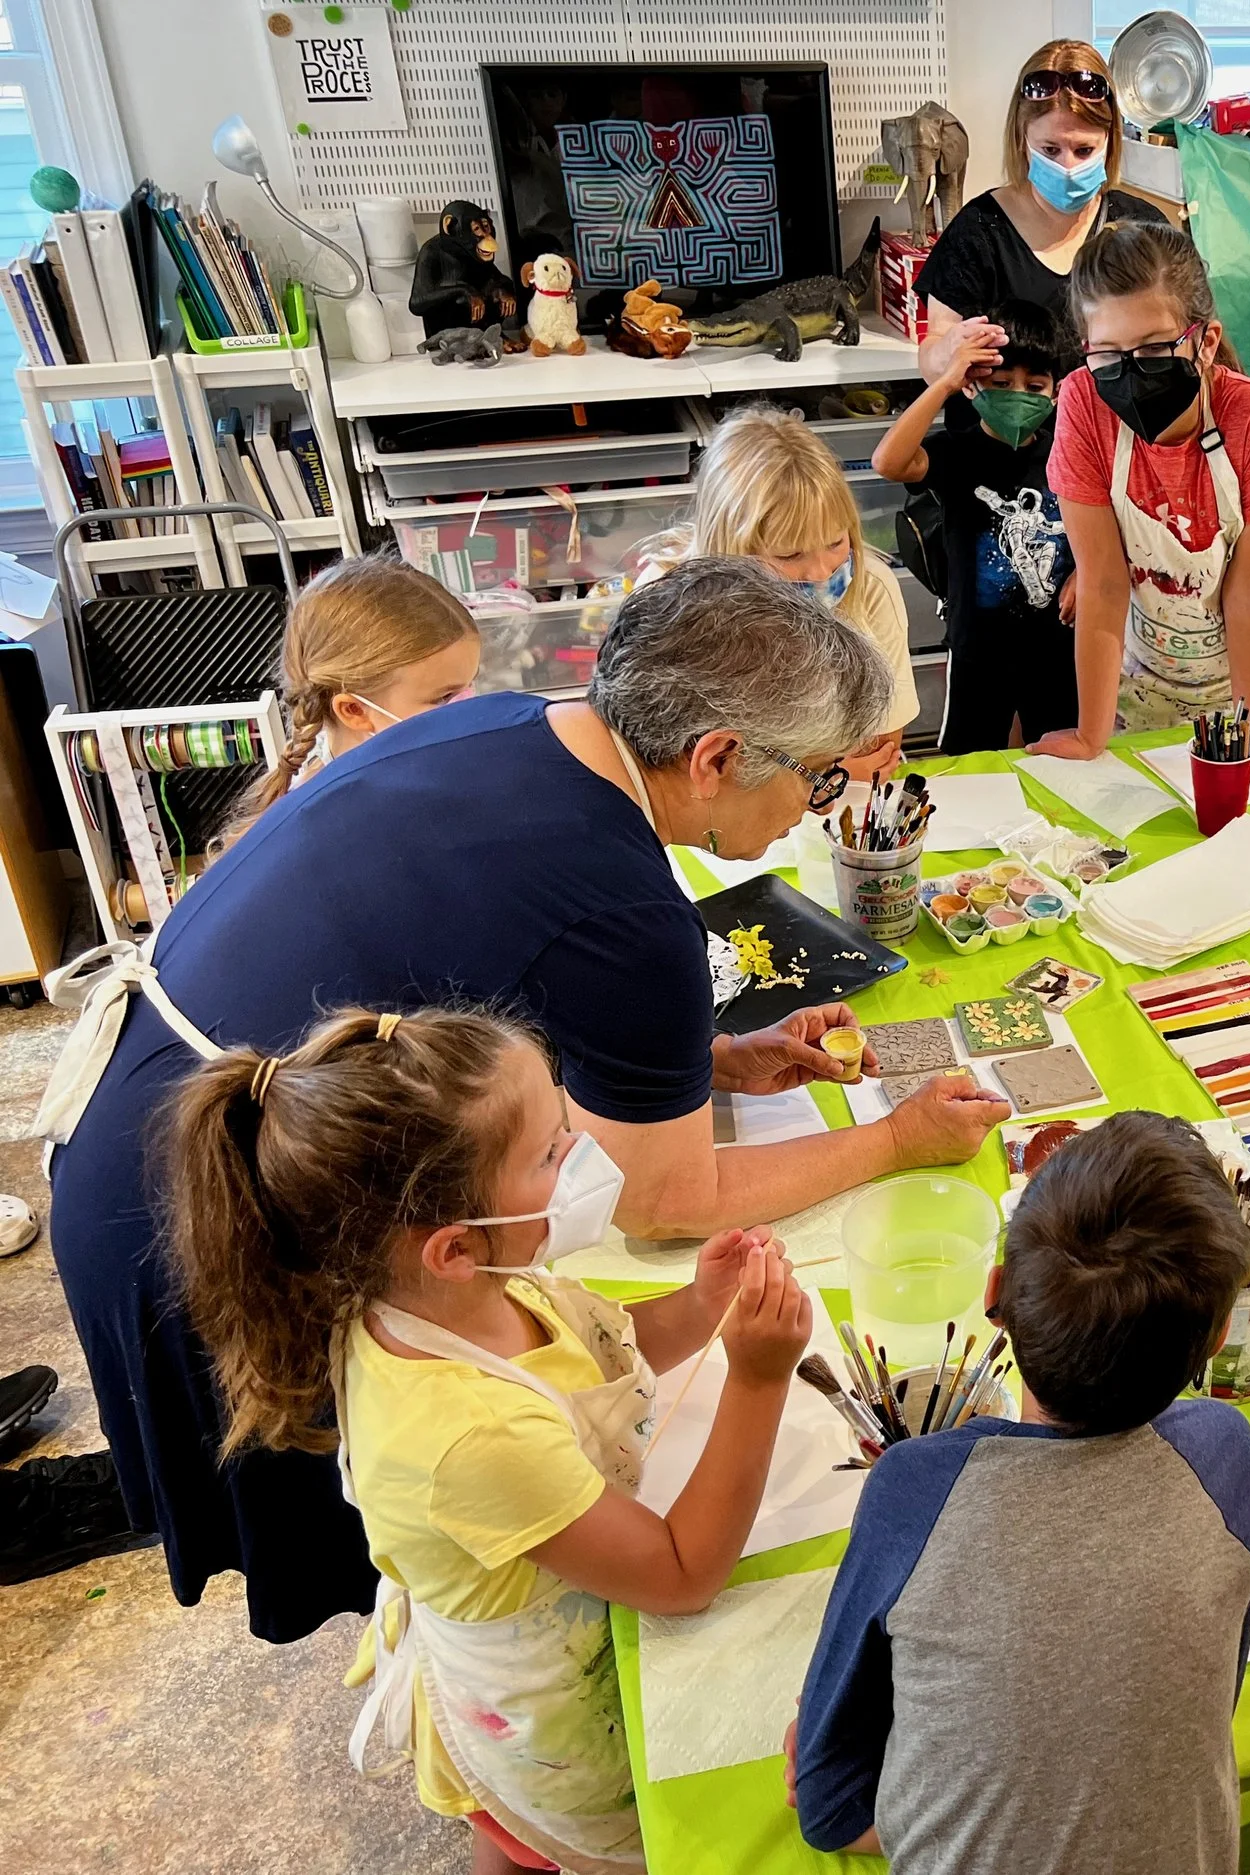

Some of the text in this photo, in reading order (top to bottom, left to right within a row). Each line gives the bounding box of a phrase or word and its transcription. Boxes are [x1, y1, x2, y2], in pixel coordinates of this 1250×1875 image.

[295, 38, 364, 67] TRUST
[326, 53, 368, 70] THE
[301, 62, 372, 94] PROCESS
[226, 335, 279, 347] COLLAGE
